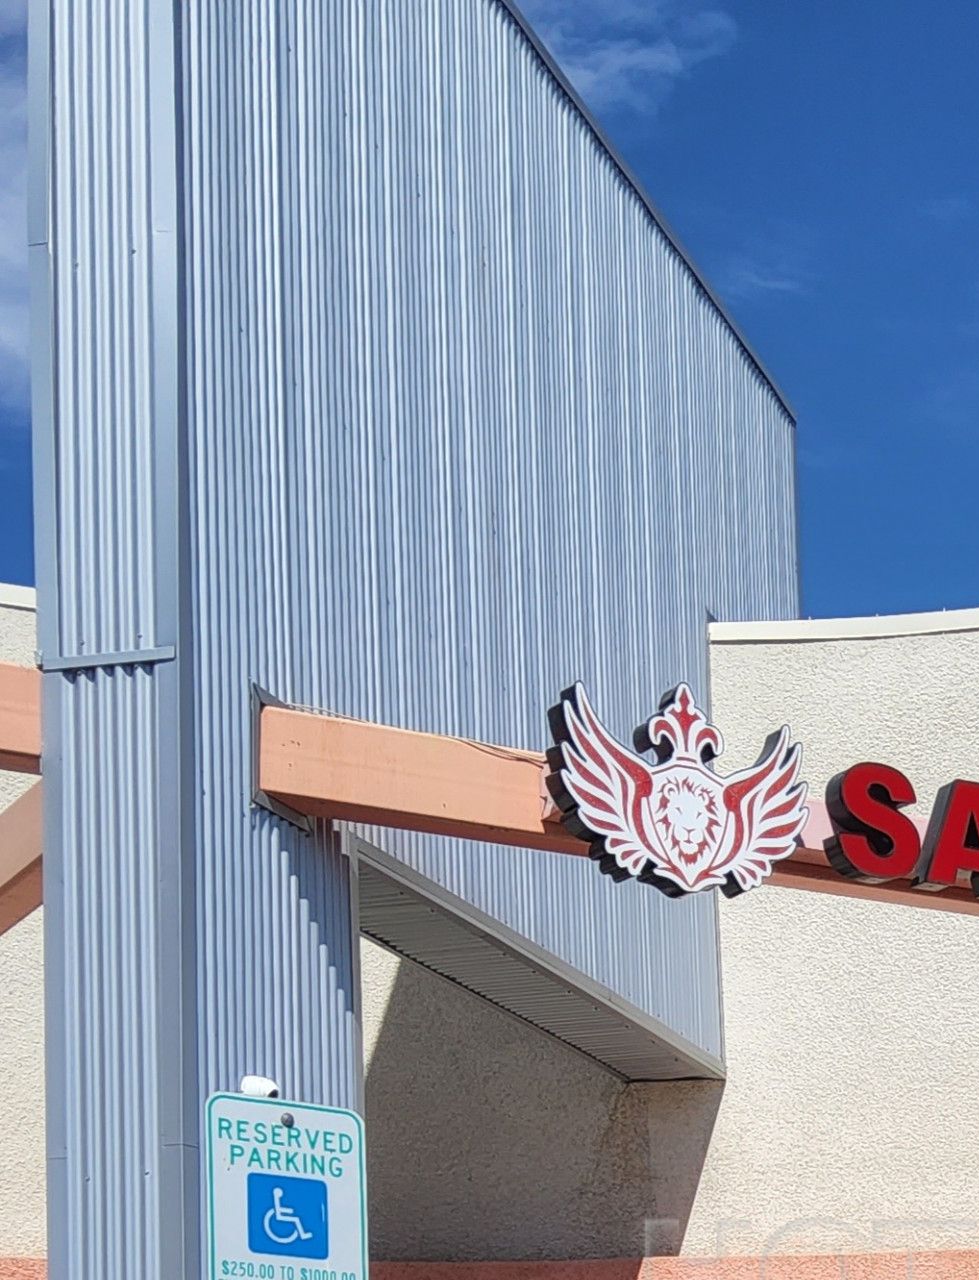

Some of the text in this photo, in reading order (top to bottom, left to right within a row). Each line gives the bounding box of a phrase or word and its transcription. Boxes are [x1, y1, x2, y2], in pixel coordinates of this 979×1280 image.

[218, 1117, 353, 1154] RESERVED
[229, 1144, 343, 1178] PARKING
[221, 1260, 275, 1279] $250.00
[280, 1266, 294, 1280] TO
